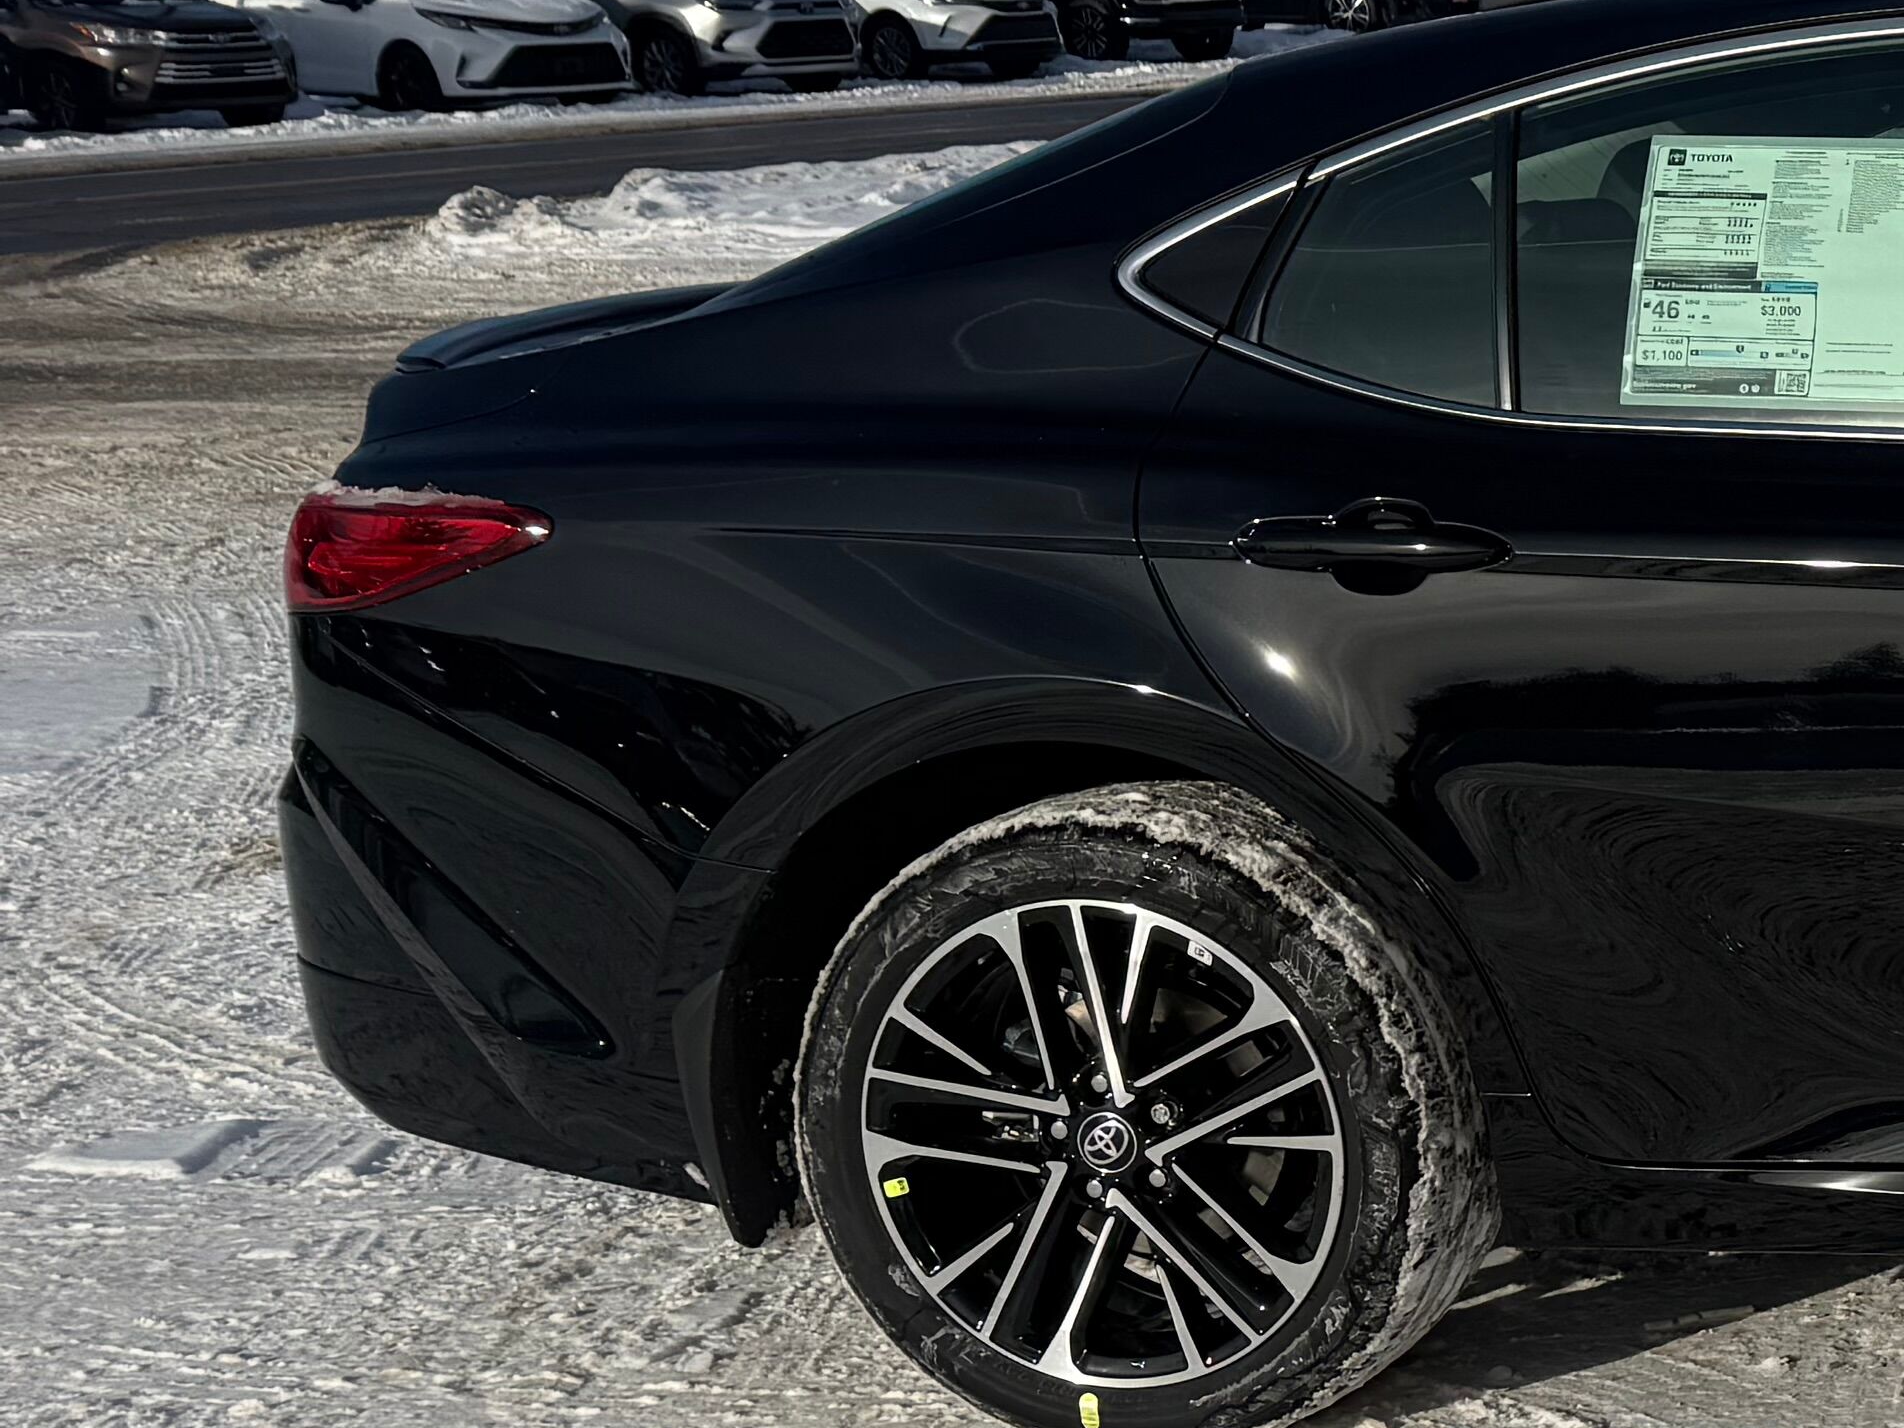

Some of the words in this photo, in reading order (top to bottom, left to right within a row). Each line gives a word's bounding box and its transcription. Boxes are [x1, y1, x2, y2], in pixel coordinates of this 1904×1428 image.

[1691, 153, 1733, 163] TOYOTA
[1652, 300, 1681, 320] 46
[1642, 349, 1683, 362] $1,100
